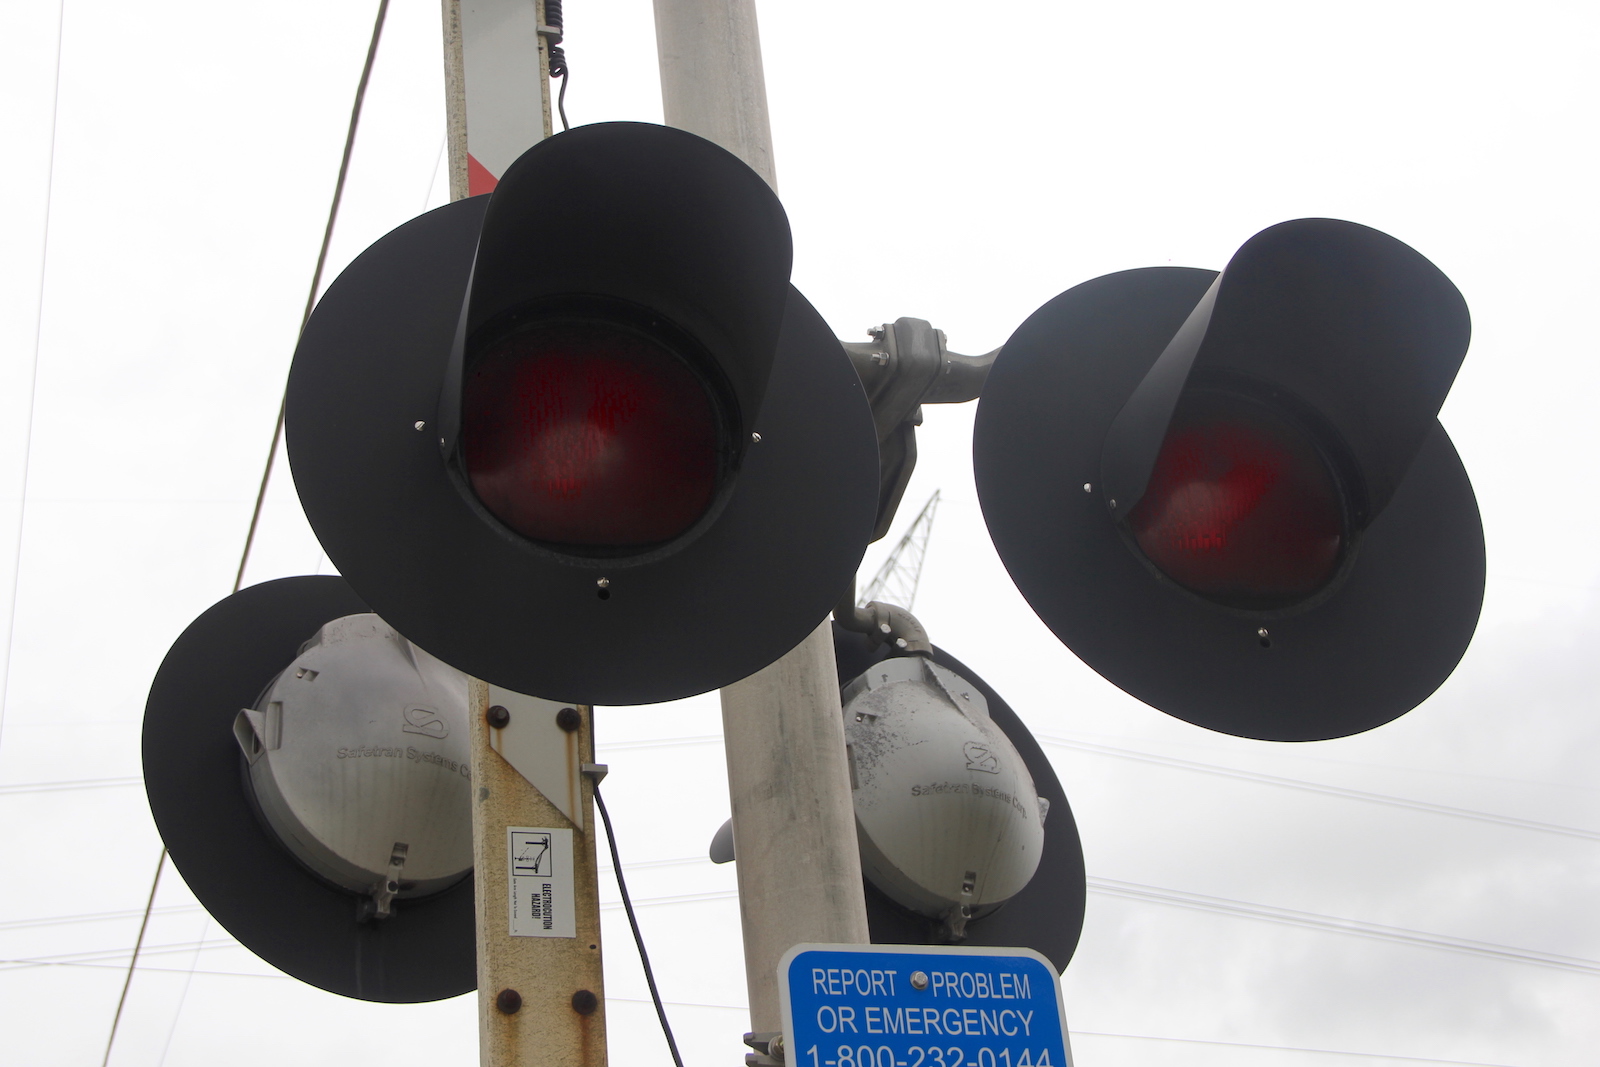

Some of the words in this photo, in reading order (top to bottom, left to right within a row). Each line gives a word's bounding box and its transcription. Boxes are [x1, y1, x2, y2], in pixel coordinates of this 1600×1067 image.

[336, 745, 403, 760] Safetran
[406, 746, 458, 773] Systems
[971, 782, 1011, 804] Systems
[531, 893, 541, 919] HAZARD!
[542, 883, 553, 930] ELECTROCUTION
[812, 968, 898, 996] REPORT
[931, 971, 1032, 1000] PROBLEM
[816, 1005, 859, 1034] OR
[865, 1007, 1034, 1037] EMERGENCY
[806, 1044, 1055, 1067] 1-800-232-0144
